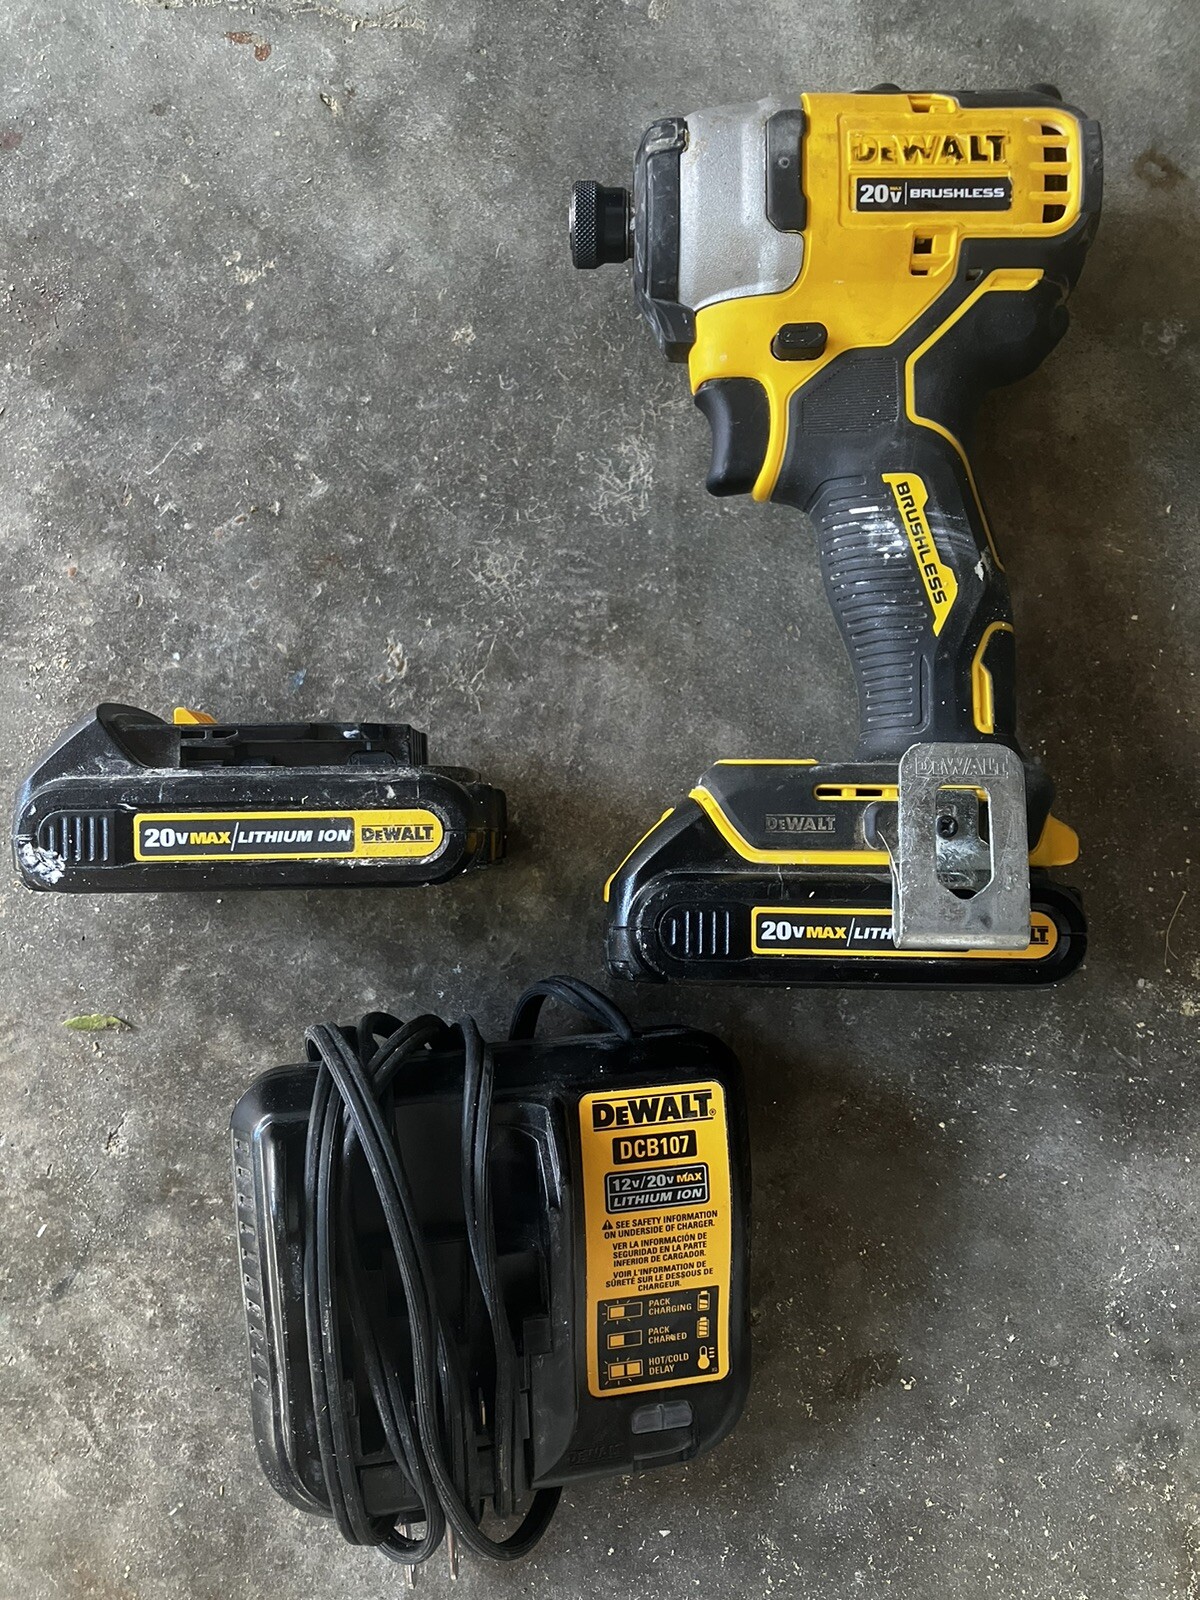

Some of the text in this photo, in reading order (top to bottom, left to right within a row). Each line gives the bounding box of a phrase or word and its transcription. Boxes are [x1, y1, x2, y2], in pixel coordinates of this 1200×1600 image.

[909, 188, 1005, 199] BRUSHLESS
[896, 481, 947, 605] BRUSHLESS
[765, 816, 836, 831] DEWALT
[237, 830, 312, 845] LITHIUM
[317, 829, 351, 842] ION
[361, 826, 434, 842] DEWALT
[853, 927, 894, 940] LITH
[592, 1093, 713, 1128] DEWALT
[620, 1135, 690, 1160] DCB107
[676, 1171, 702, 1183] MAX
[613, 1188, 703, 1207] LITHIUM ION
[615, 1210, 718, 1229] SEE SAFETY INFORMATION
[604, 1219, 715, 1240] ON UNDERSIDE OF CHARGER.
[612, 1232, 708, 1251] VER LA INFORMACIÓN DE
[613, 1241, 707, 1260] SEGURIDAD EN LA PARTE
[613, 1249, 706, 1268] INFERIOR DE CARGADOR.
[605, 1267, 714, 1288] SÛRETÉ SUR LE DESSOUS DE
[613, 1260, 707, 1279] VOIR L'INFORMATION DE
[638, 1280, 682, 1292] CHARGEUR.
[648, 1298, 671, 1307] PACK
[648, 1303, 692, 1316] CHARGING
[648, 1326, 670, 1336] PACK
[648, 1352, 690, 1366] HOT/COLD
[649, 1364, 675, 1376] DELAY
